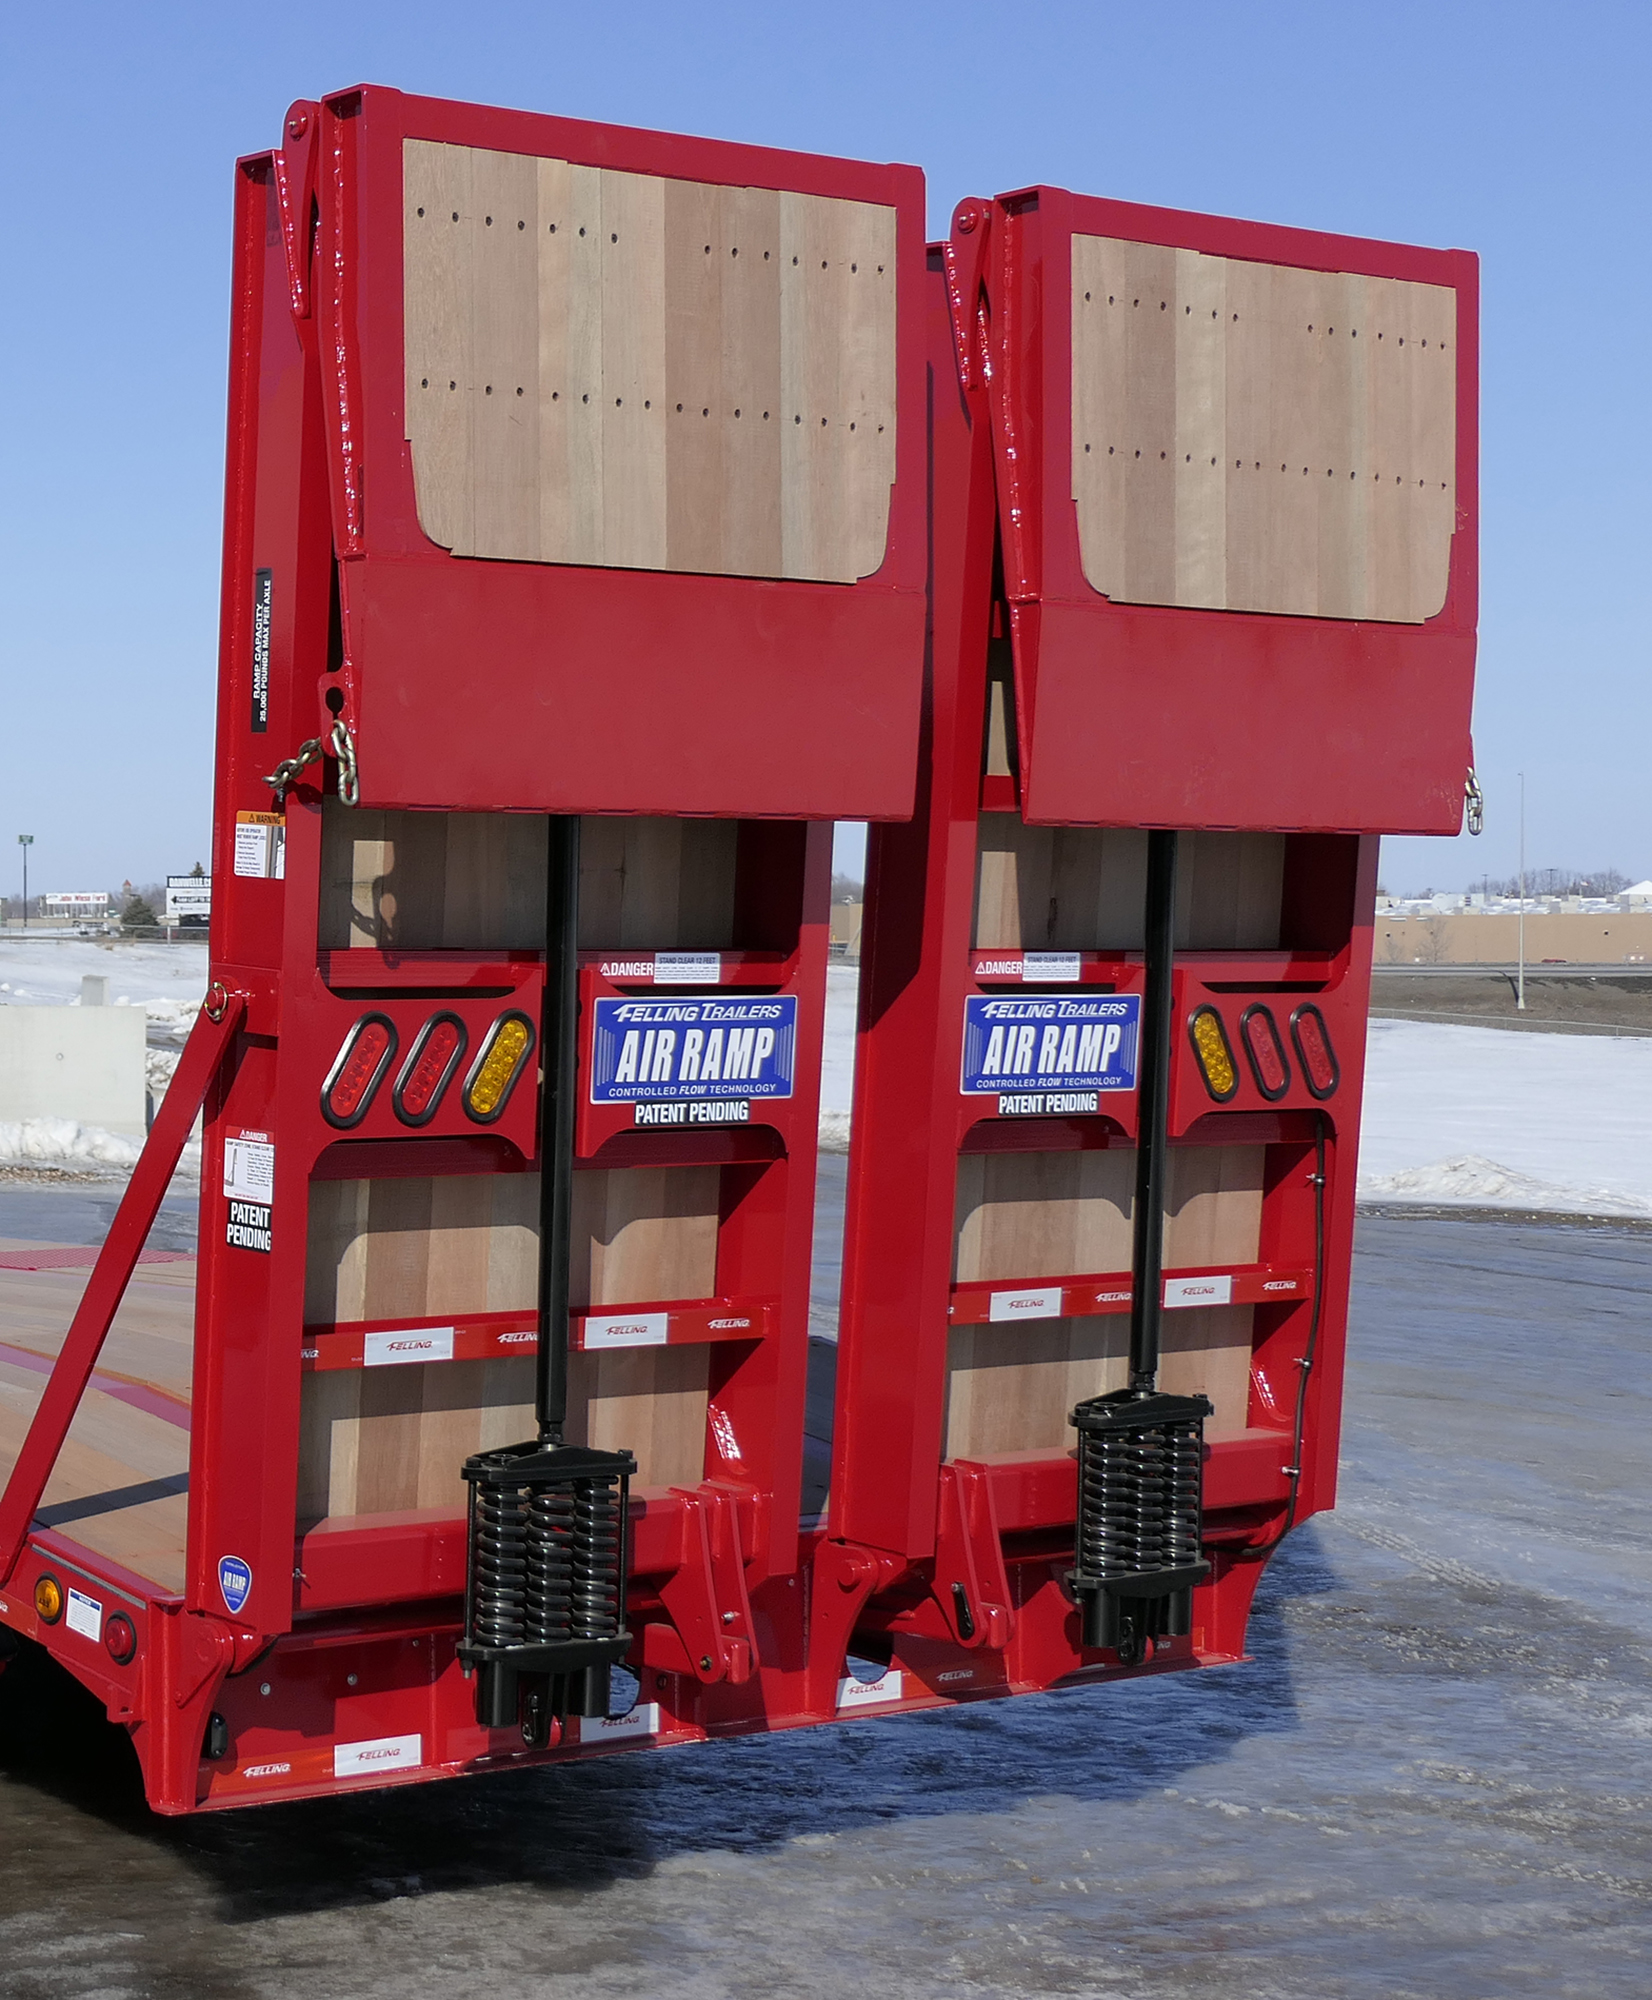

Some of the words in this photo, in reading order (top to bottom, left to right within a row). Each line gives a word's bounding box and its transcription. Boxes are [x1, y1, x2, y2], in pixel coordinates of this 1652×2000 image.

[254, 603, 263, 662] CAPACITY
[261, 650, 269, 689] POUNDS
[253, 664, 261, 699] RAMP
[259, 690, 267, 722] 25,000
[611, 962, 654, 976] DANGER
[985, 961, 1023, 974] DANGER
[612, 1003, 699, 1023] FELLING
[700, 1003, 782, 1021] TRAILERS
[980, 1001, 1056, 1019] FELLING
[1057, 1001, 1129, 1018] TRAILERS
[615, 1029, 676, 1082] AIR
[678, 1027, 775, 1081] RAMP
[981, 1025, 1036, 1075] AIR
[1037, 1024, 1121, 1073] RAMP
[976, 1078, 1036, 1089] CONTROLLED
[1037, 1077, 1063, 1087] FLOW
[1064, 1076, 1122, 1086] TECHNOLOGY
[608, 1087, 677, 1097] CONTROLLED
[679, 1085, 707, 1095] FLOW
[709, 1083, 776, 1094] TECHNOLOGY
[998, 1095, 1045, 1114] PATENT
[1046, 1093, 1098, 1112] PENDING
[635, 1103, 687, 1125] PATENT
[688, 1101, 749, 1122] PENDING
[246, 1130, 268, 1143] DANGER
[231, 1201, 271, 1227] PATENT
[226, 1223, 272, 1251] PENDING
[1180, 1285, 1215, 1296] FELLING
[1262, 1280, 1297, 1291] FELLING
[1007, 1298, 1044, 1309] FELLING
[1095, 1291, 1132, 1302] FELLING
[605, 1324, 648, 1335] FELLING
[707, 1317, 750, 1329] FELLING
[497, 1331, 538, 1343] FELLIN
[386, 1339, 432, 1351] FELLING
[936, 1669, 973, 1681] FELLING
[847, 1683, 884, 1695] FELLING
[355, 1748, 401, 1761] FELLING
[243, 1762, 291, 1778] FELLING
